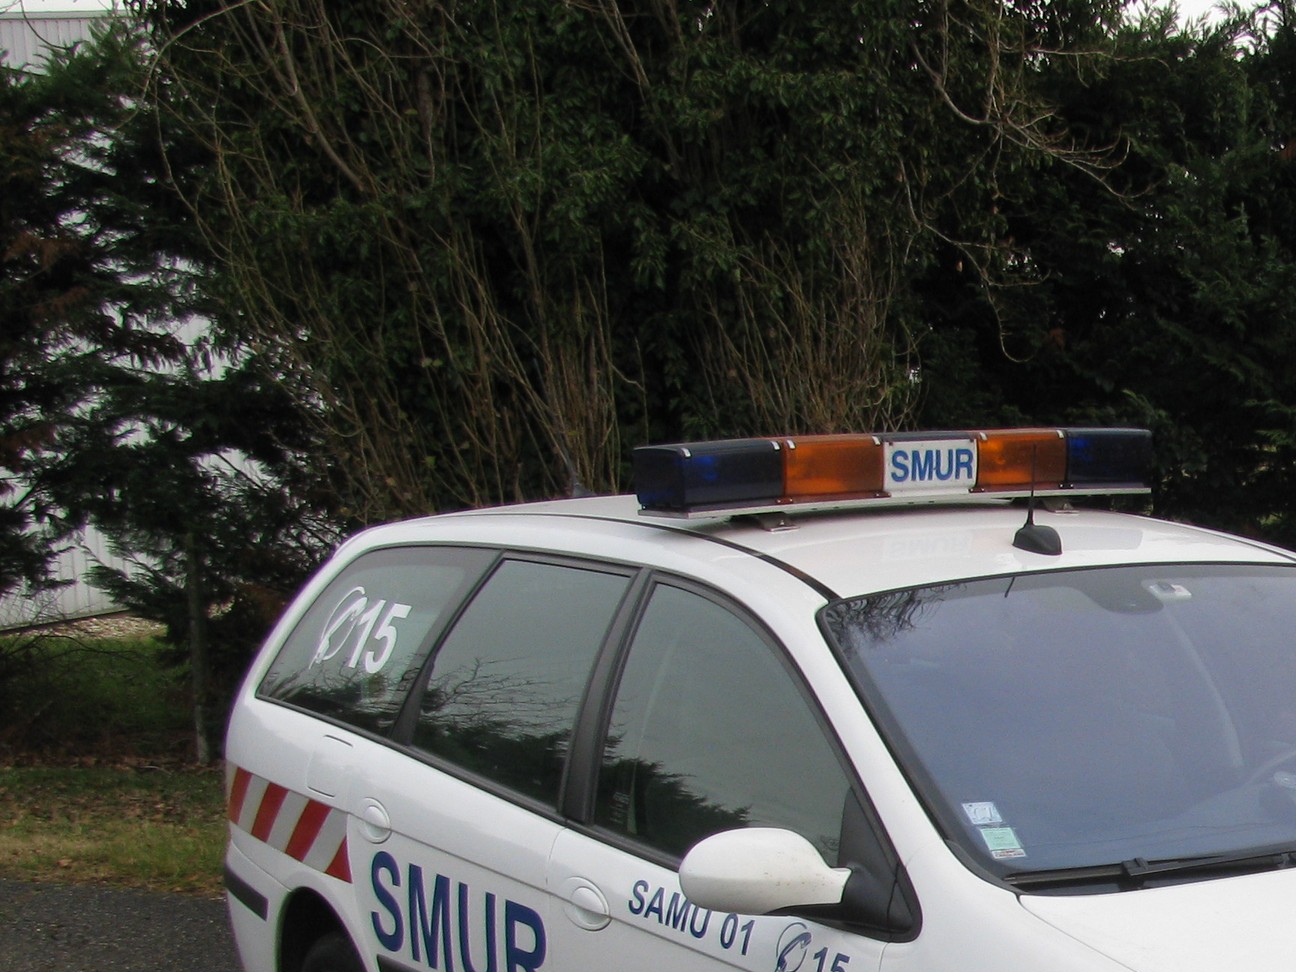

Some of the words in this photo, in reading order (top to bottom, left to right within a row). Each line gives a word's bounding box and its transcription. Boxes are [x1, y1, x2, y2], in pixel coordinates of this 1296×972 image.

[890, 448, 975, 483] SMUR
[348, 599, 412, 674] 15
[628, 879, 712, 939] SAMU
[720, 912, 755, 956] 01
